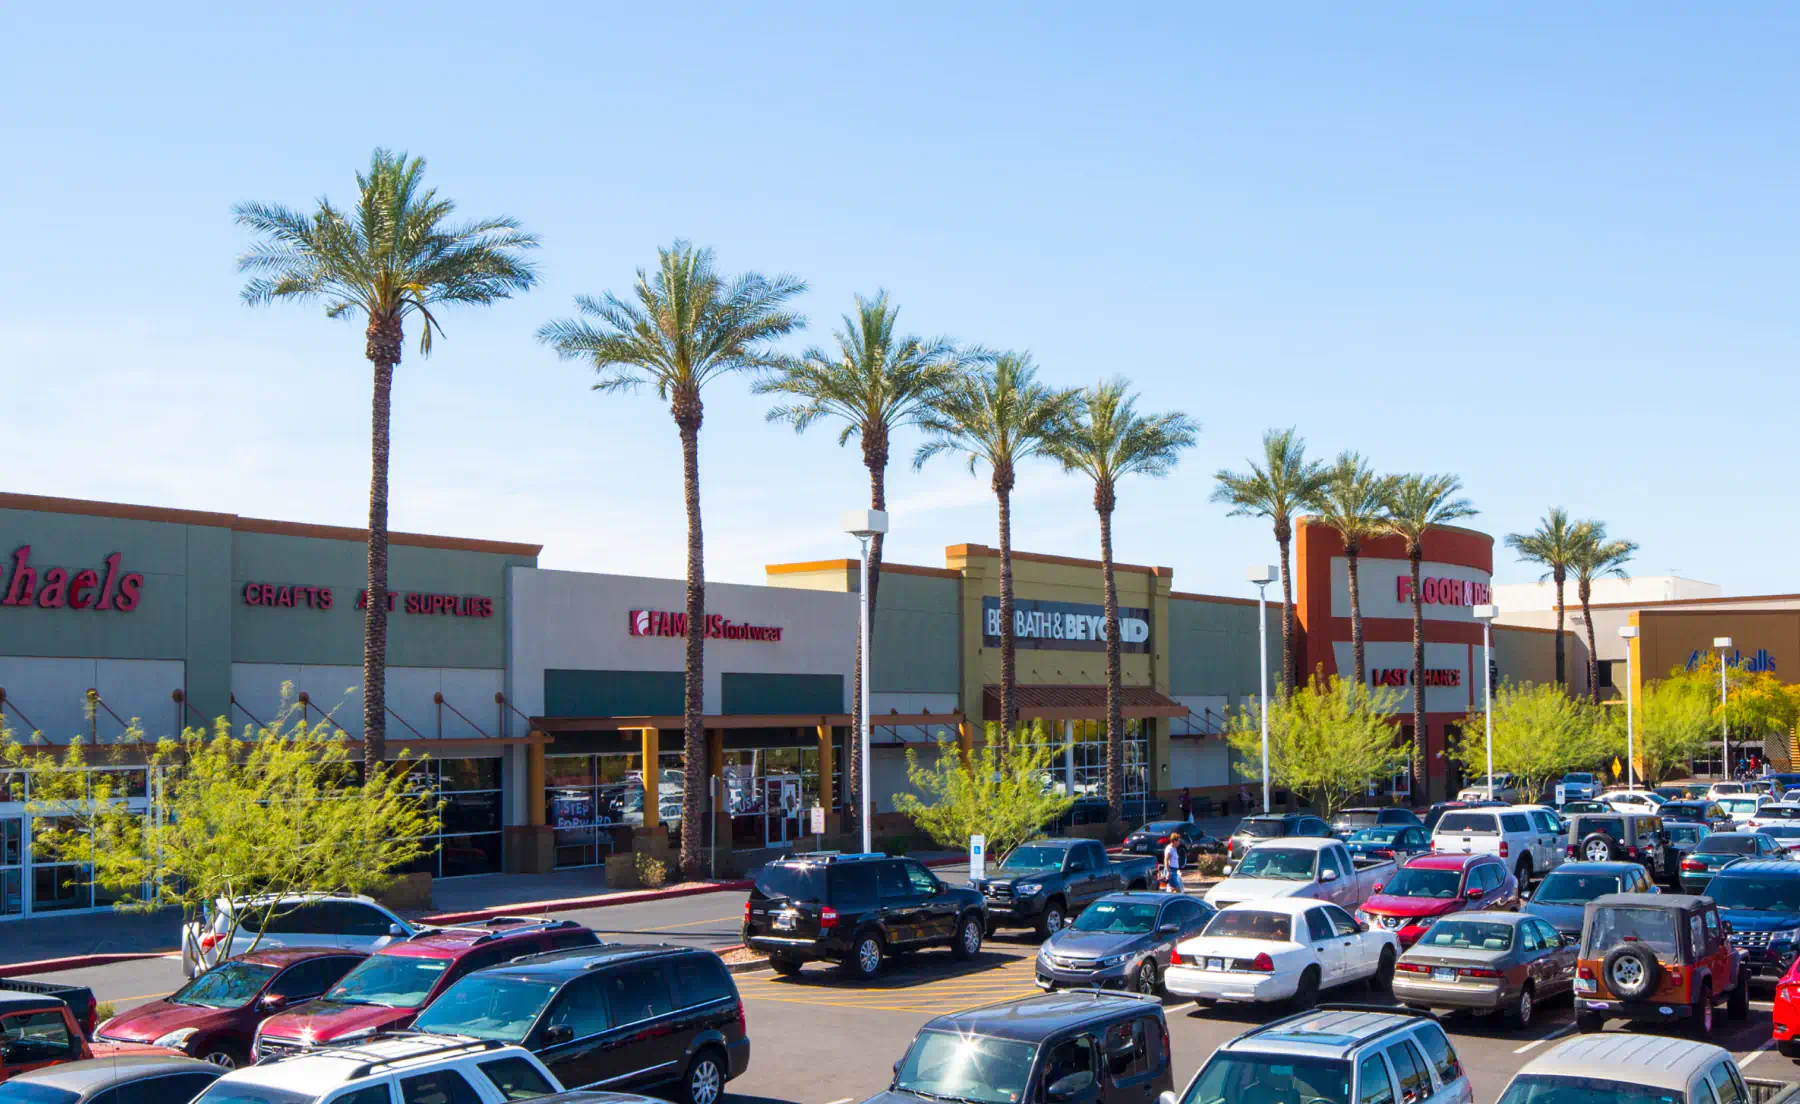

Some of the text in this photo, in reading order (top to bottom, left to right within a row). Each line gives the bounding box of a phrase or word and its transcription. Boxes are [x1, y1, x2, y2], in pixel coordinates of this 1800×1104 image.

[0, 544, 144, 612] haels
[1397, 576, 1463, 606] FOOR
[245, 584, 494, 617] CRAFTS AT SUPPLIES
[651, 611, 783, 641] FAMUS footwear
[1016, 610, 1052, 639] BATH
[1053, 612, 1064, 639] &
[1373, 668, 1461, 687] LAST HANCE
